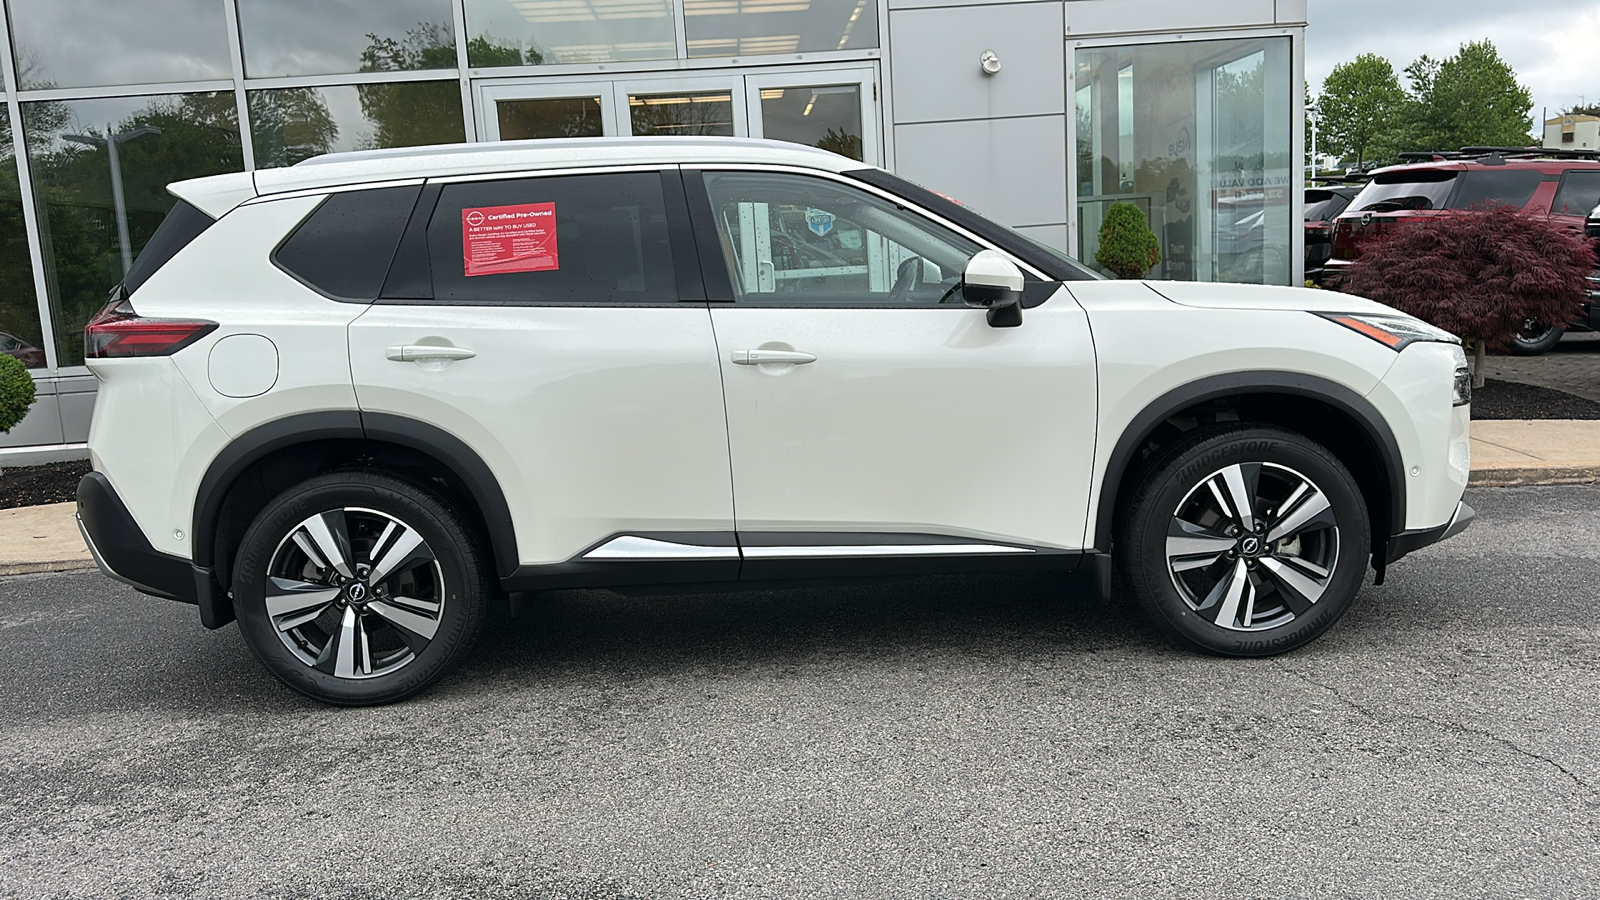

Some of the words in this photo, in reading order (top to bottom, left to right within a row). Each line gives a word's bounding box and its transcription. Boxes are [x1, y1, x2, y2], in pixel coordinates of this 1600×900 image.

[488, 212, 515, 221] Certified
[516, 210, 552, 219] Pre-Owned
[1175, 441, 1279, 486] BRIDGESTONE
[1234, 608, 1333, 653] BRIDGESTONE
